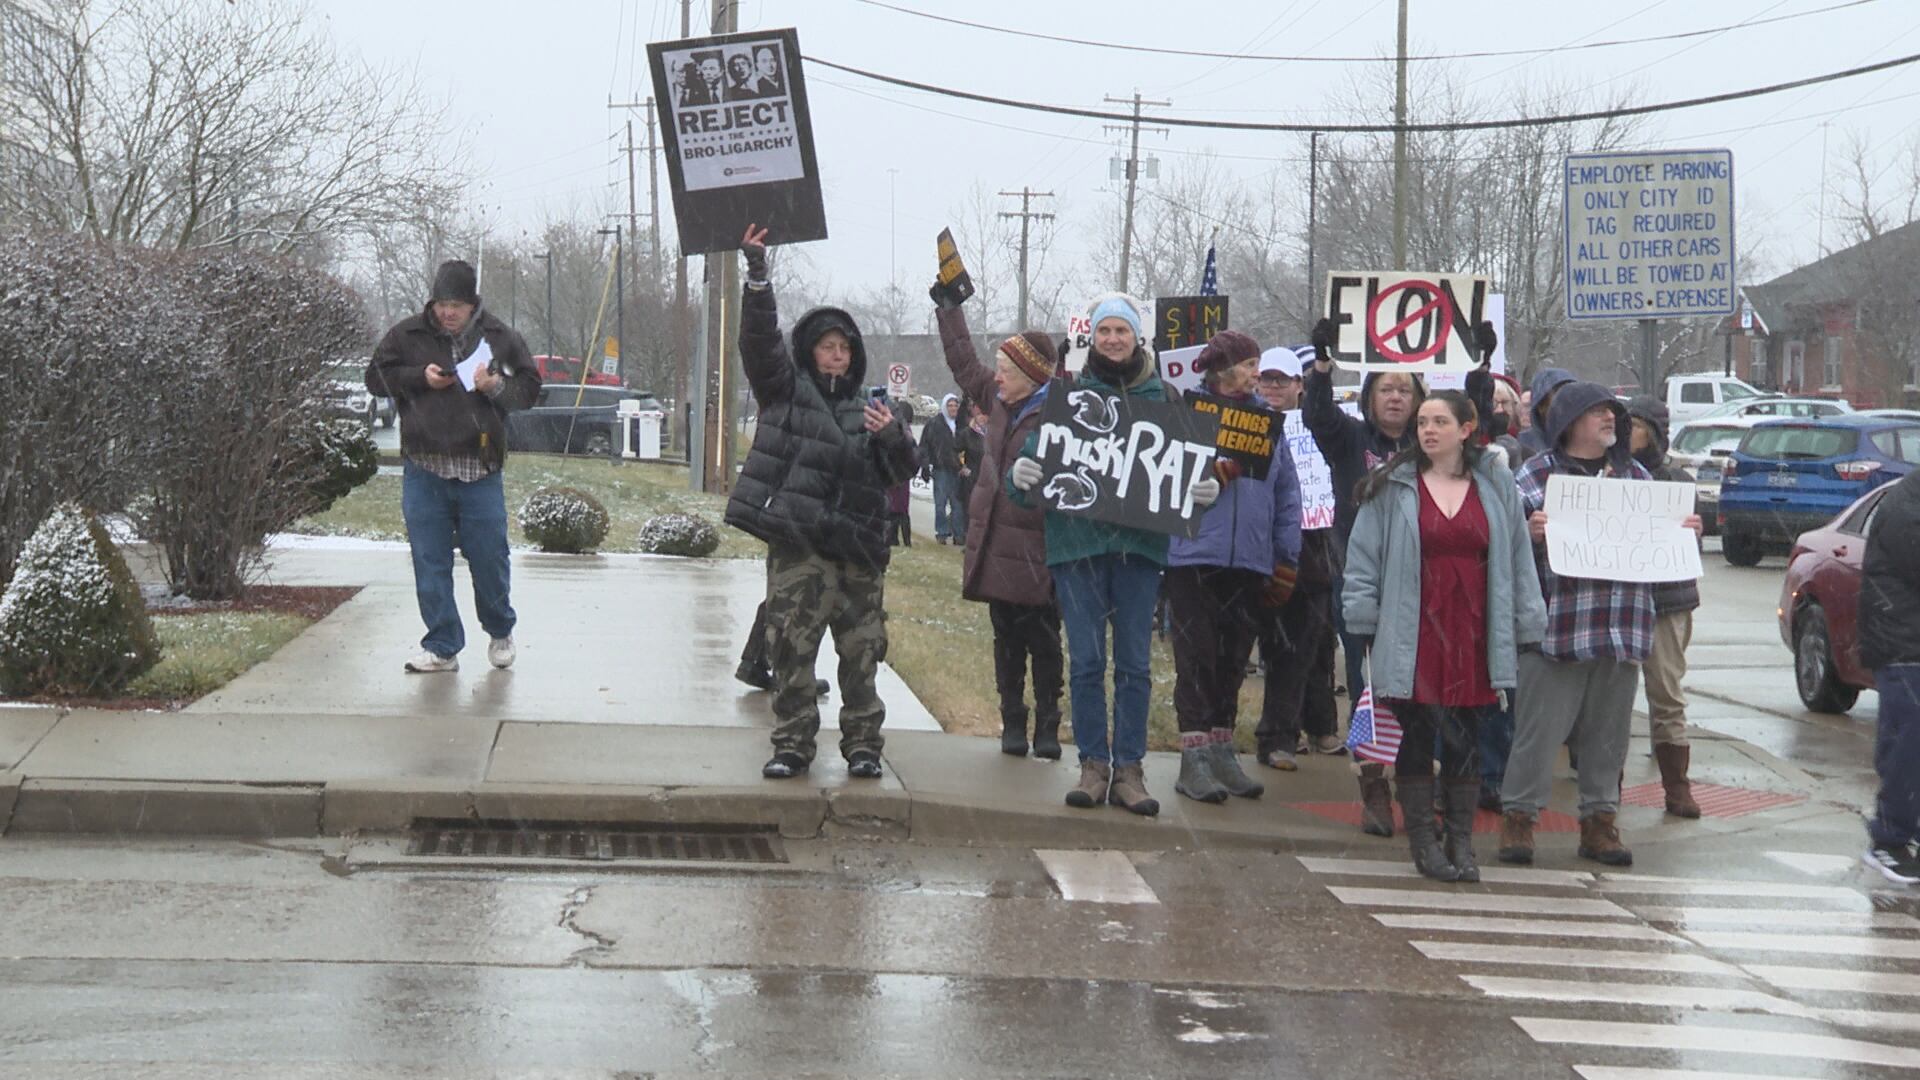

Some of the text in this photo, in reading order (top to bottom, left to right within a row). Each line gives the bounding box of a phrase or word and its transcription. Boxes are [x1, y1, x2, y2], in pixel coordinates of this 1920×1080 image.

[677, 101, 788, 134] REJECT
[684, 136, 793, 160] BRO-LIGARCHY
[728, 132, 745, 140] THE
[1570, 161, 1727, 185] EMPLOYEE PARKING
[1584, 187, 1714, 210] ONLY CITY ID
[1586, 213, 1716, 235] TAG REQUIRED
[1577, 237, 1721, 261] ALL OTHER CARS
[1573, 262, 1728, 286] WILL BE TOWED AT
[1574, 288, 1728, 312] OWNERS EXPENSE
[1330, 276, 1486, 365] ELON
[1221, 407, 1271, 434] KINGS
[1560, 481, 1607, 513] HELL
[1621, 485, 1653, 514] NO
[1586, 513, 1668, 544] DOGE
[1562, 541, 1624, 570] MUST
